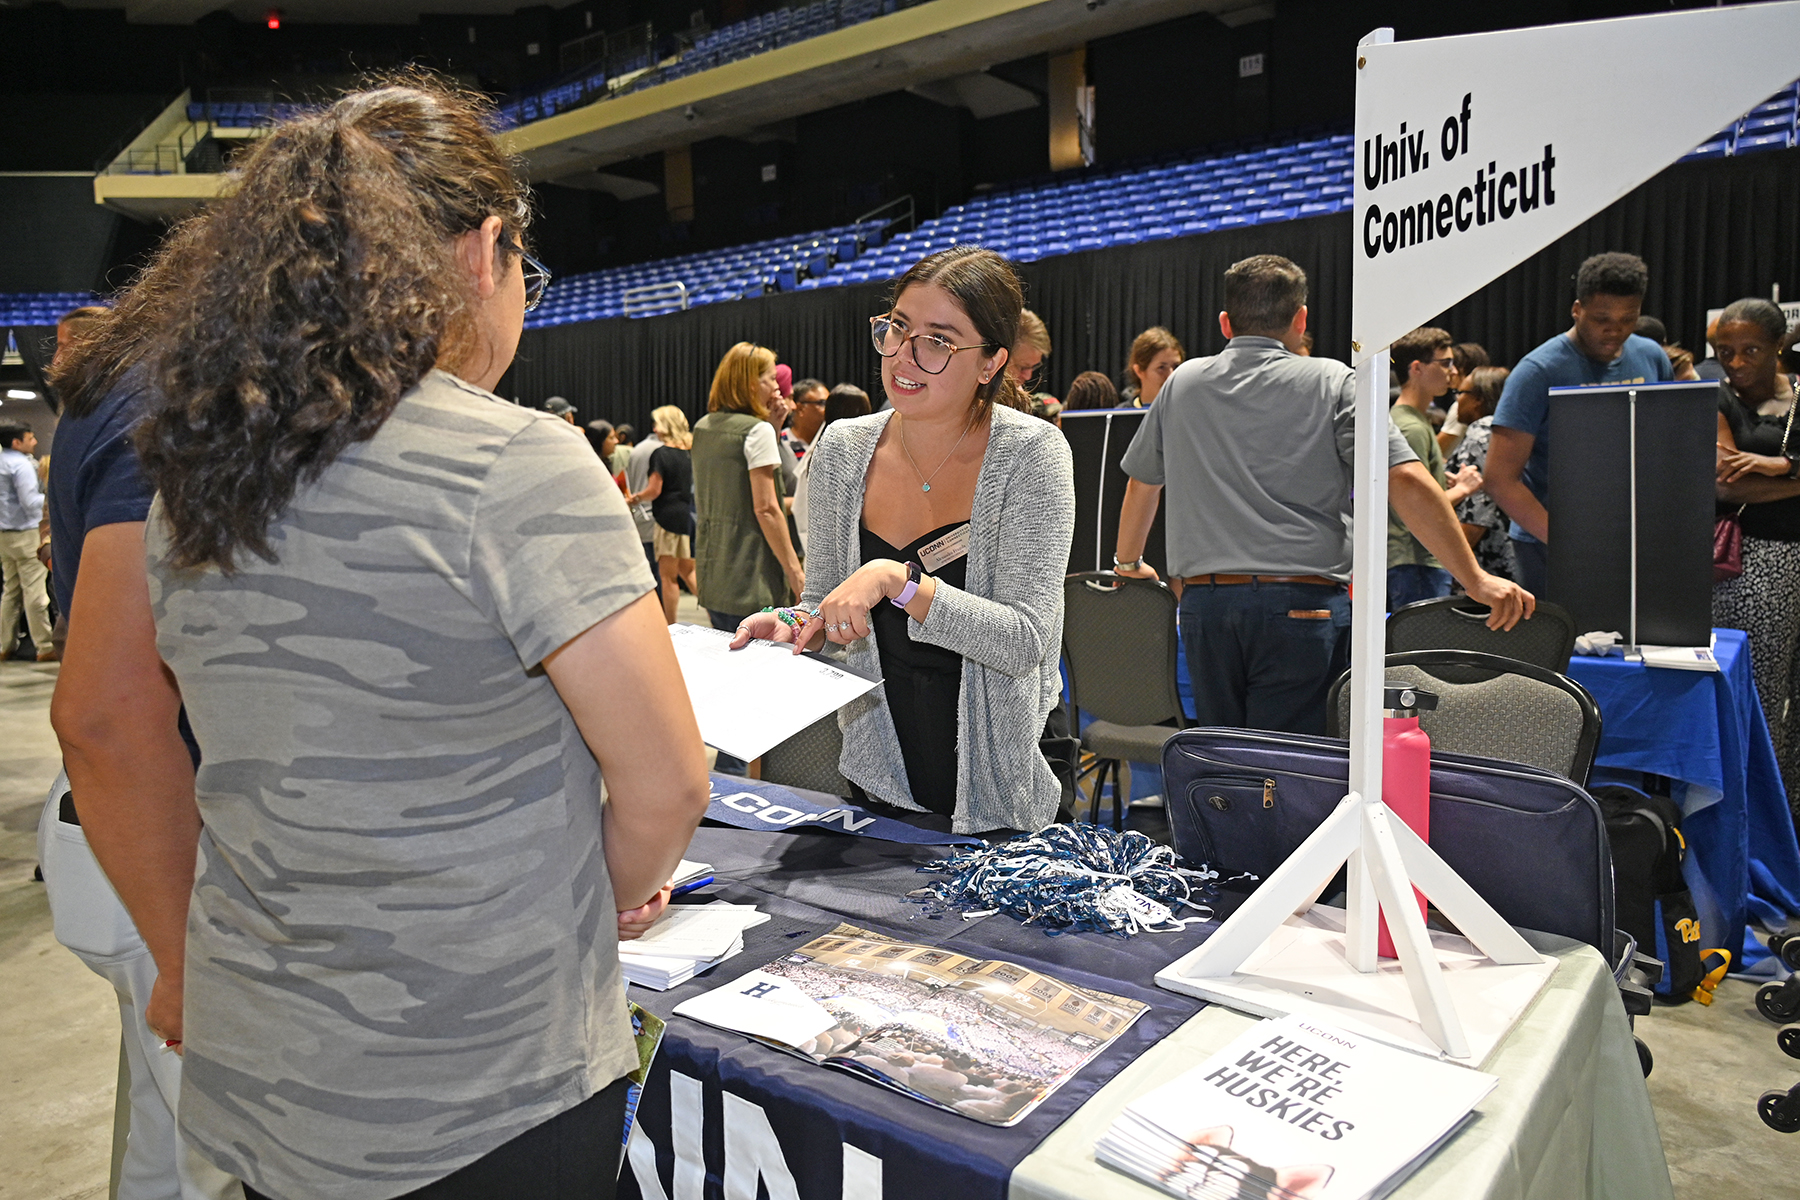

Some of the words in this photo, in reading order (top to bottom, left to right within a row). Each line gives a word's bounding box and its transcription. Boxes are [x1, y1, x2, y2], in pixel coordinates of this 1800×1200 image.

[1364, 121, 1429, 191] Univ.
[1441, 92, 1472, 161] of
[1363, 143, 1556, 259] Connecticut
[920, 540, 945, 557] UCONN
[709, 792, 876, 832] CONN
[740, 982, 780, 998] H
[994, 970, 1018, 982] 2004
[1299, 1023, 1357, 1049] UCONN
[1235, 1050, 1343, 1105] WE'RE
[1259, 1035, 1351, 1085] HERE,
[1203, 1066, 1355, 1140] HUSKIES
